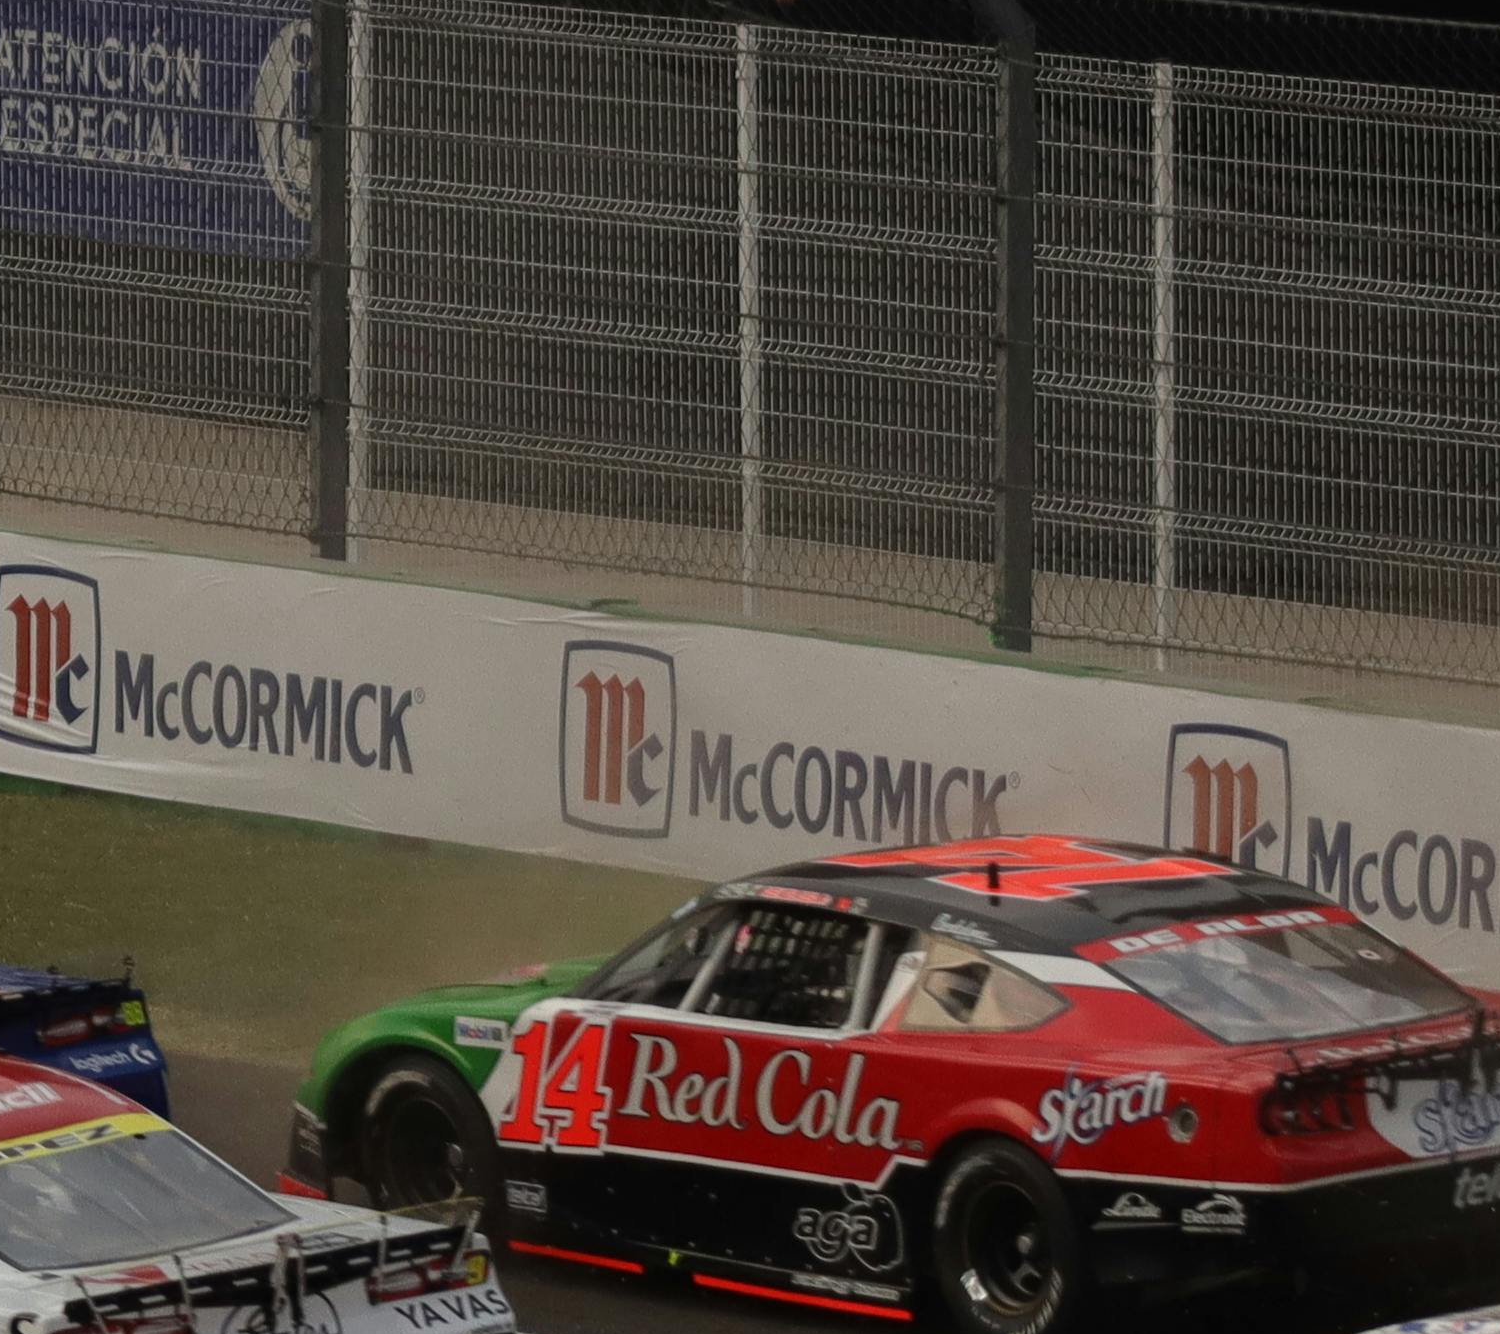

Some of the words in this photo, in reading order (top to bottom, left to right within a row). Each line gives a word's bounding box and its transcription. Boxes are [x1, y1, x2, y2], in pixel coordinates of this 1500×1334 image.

[0, 97, 194, 172] ESPECIAL
[500, 1020, 606, 1147] 14
[617, 1031, 748, 1131] Red
[755, 1048, 902, 1151] Cola
